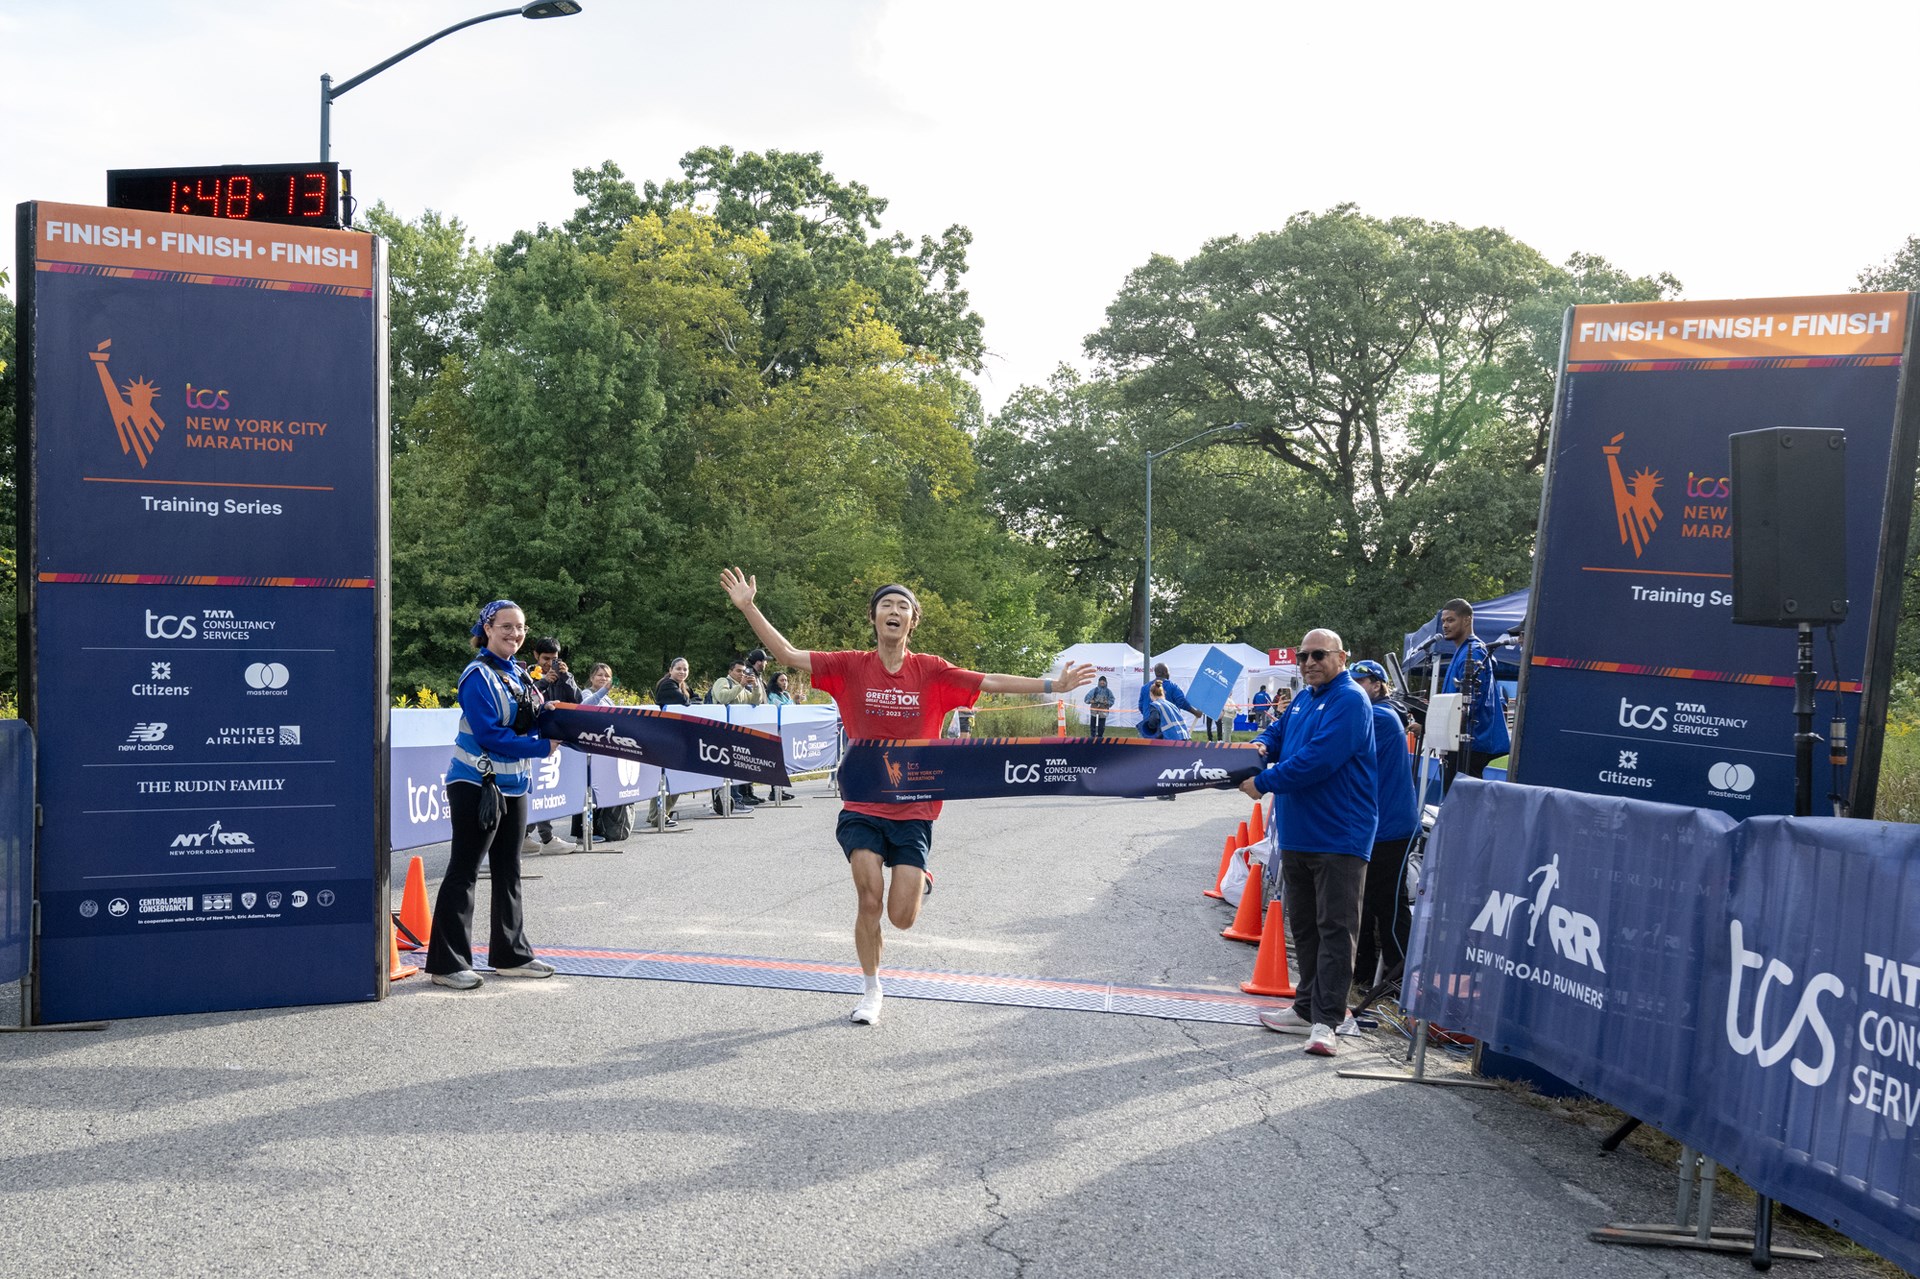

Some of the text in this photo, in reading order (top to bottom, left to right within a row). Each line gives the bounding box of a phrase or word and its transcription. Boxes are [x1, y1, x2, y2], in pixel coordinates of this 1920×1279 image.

[46, 220, 358, 269] FINISH FINISH FINISH
[1579, 312, 1891, 343] FINISH FINISH FINISH
[186, 383, 230, 410] tcs
[186, 416, 328, 436] NEW YORK CITY
[186, 434, 293, 452] MARATHON
[1687, 471, 1730, 498] tcs
[141, 496, 283, 516] Training Series
[1683, 505, 1728, 520] NEW
[1631, 585, 1705, 608] Training
[203, 610, 234, 619] TATA
[145, 609, 197, 639] tcs
[203, 620, 276, 630] CONSULTANCY
[203, 631, 250, 640] SERVICES
[131, 684, 190, 696] Citizens
[866, 691, 897, 701] GRETE'S
[897, 694, 919, 706] 10K
[1675, 702, 1706, 713] TATA
[1618, 697, 1668, 731] tcs
[1673, 713, 1748, 729] CONSULTANCY
[220, 727, 275, 735] UNITED
[1672, 724, 1719, 737] SERVICES
[138, 743, 174, 751] balance
[206, 736, 275, 745] AIRLINES
[792, 736, 807, 760] tcs
[620, 747, 643, 756] RUNNERS
[699, 738, 731, 765] tcs
[731, 745, 751, 755] TATA
[732, 753, 776, 768] CONSULTANCY
[733, 760, 761, 772] SERVICES
[907, 761, 919, 770] tcs
[1045, 758, 1067, 766] TATA
[1004, 759, 1041, 784] tcs
[1044, 766, 1097, 774] CONSULTANCY
[137, 778, 286, 793] THE RUDIN FAMILY
[1044, 775, 1077, 783] SERVICES
[1598, 770, 1653, 788] Citizens
[408, 777, 440, 824] tcs
[532, 793, 567, 810] new balance
[1708, 790, 1751, 801] mastercard
[139, 897, 186, 906] CENTRAL PARK
[139, 904, 187, 913] CONSERVANCY
[1466, 946, 1493, 967] NEW
[1504, 959, 1551, 986] ROAD
[1552, 973, 1604, 1010] RUNNERS
[1864, 952, 1920, 1009] TAT
[1726, 919, 1845, 1087] tcs
[1858, 1010, 1920, 1067] CON
